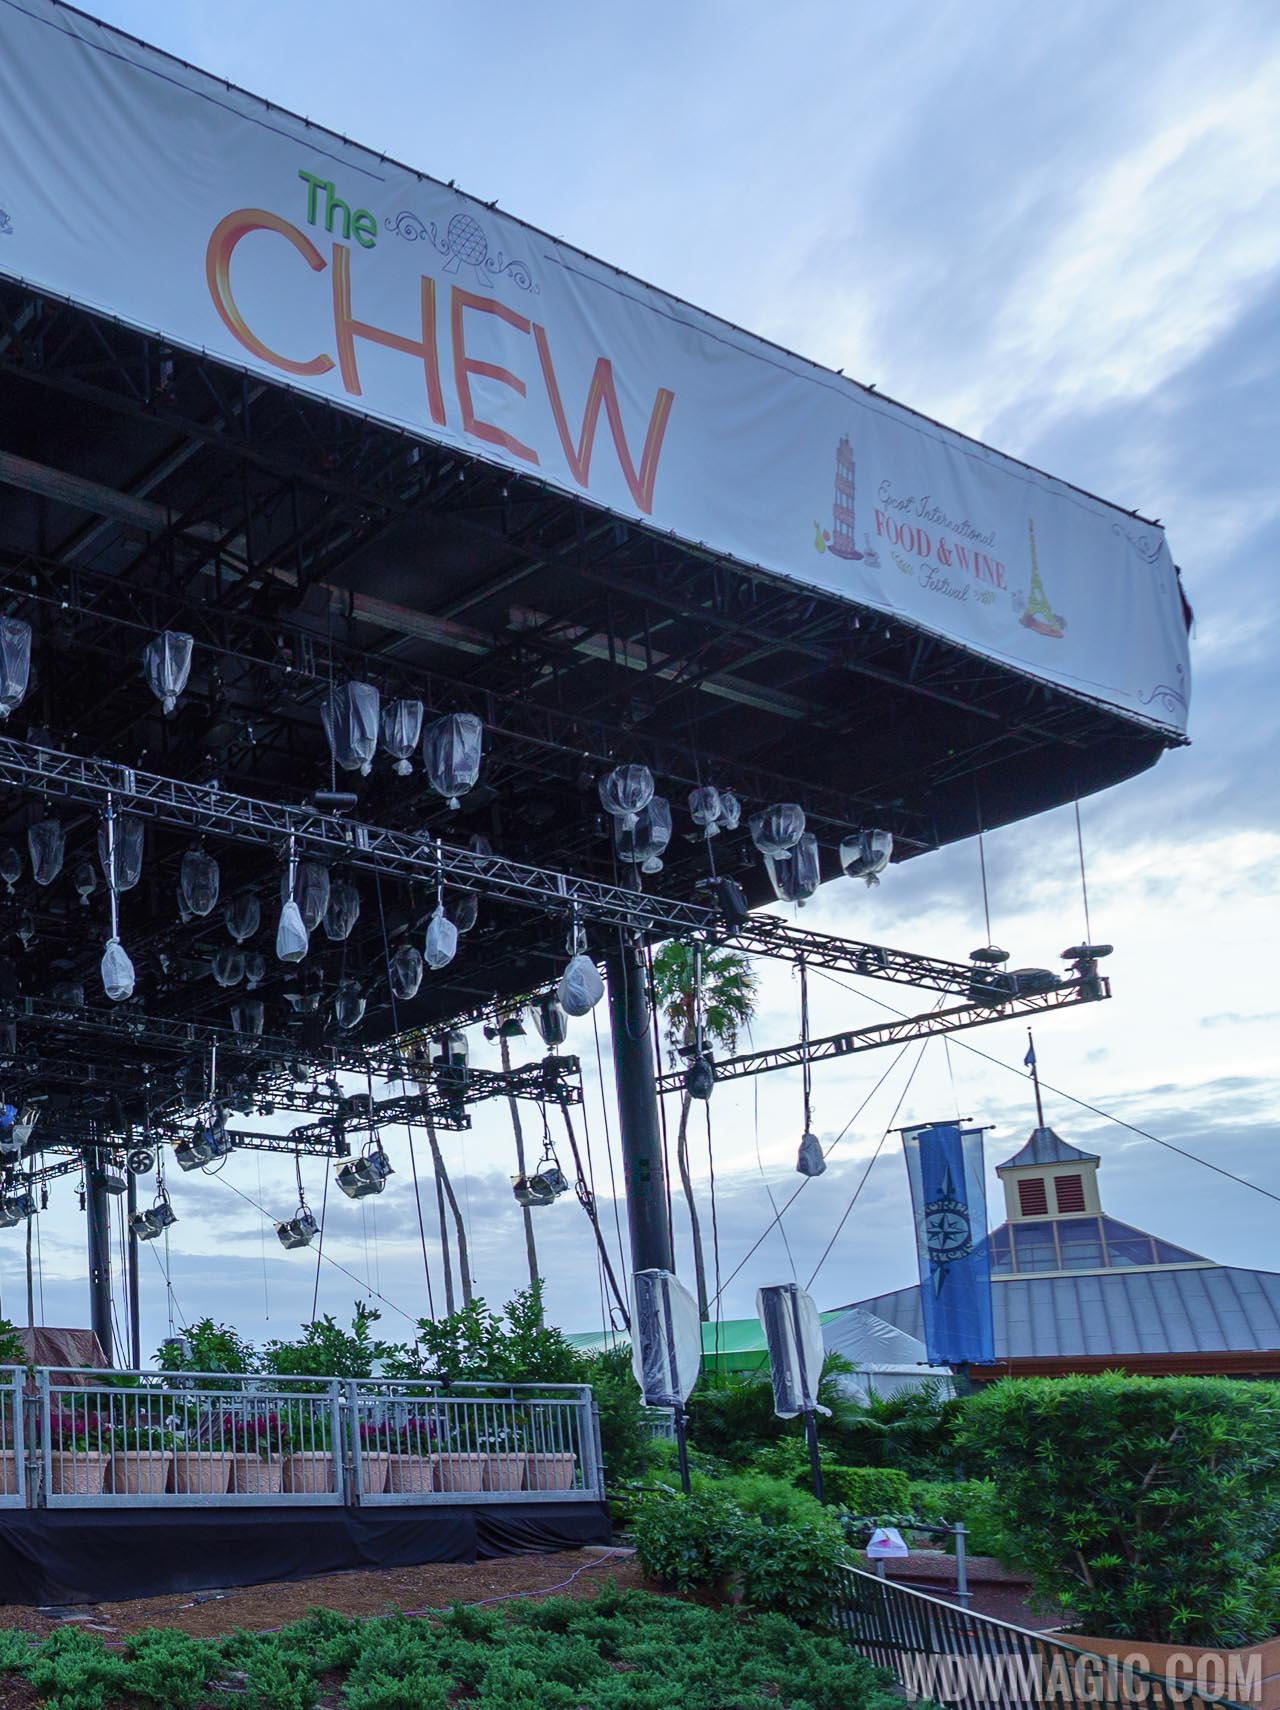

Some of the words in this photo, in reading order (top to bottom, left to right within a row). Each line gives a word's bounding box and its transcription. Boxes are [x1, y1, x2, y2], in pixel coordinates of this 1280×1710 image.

[298, 169, 378, 249] The
[206, 208, 676, 515] CHEW
[873, 507, 932, 558] FOOD
[954, 543, 1008, 591] WINE
[915, 495, 997, 548] International
[919, 563, 971, 601] Festival
